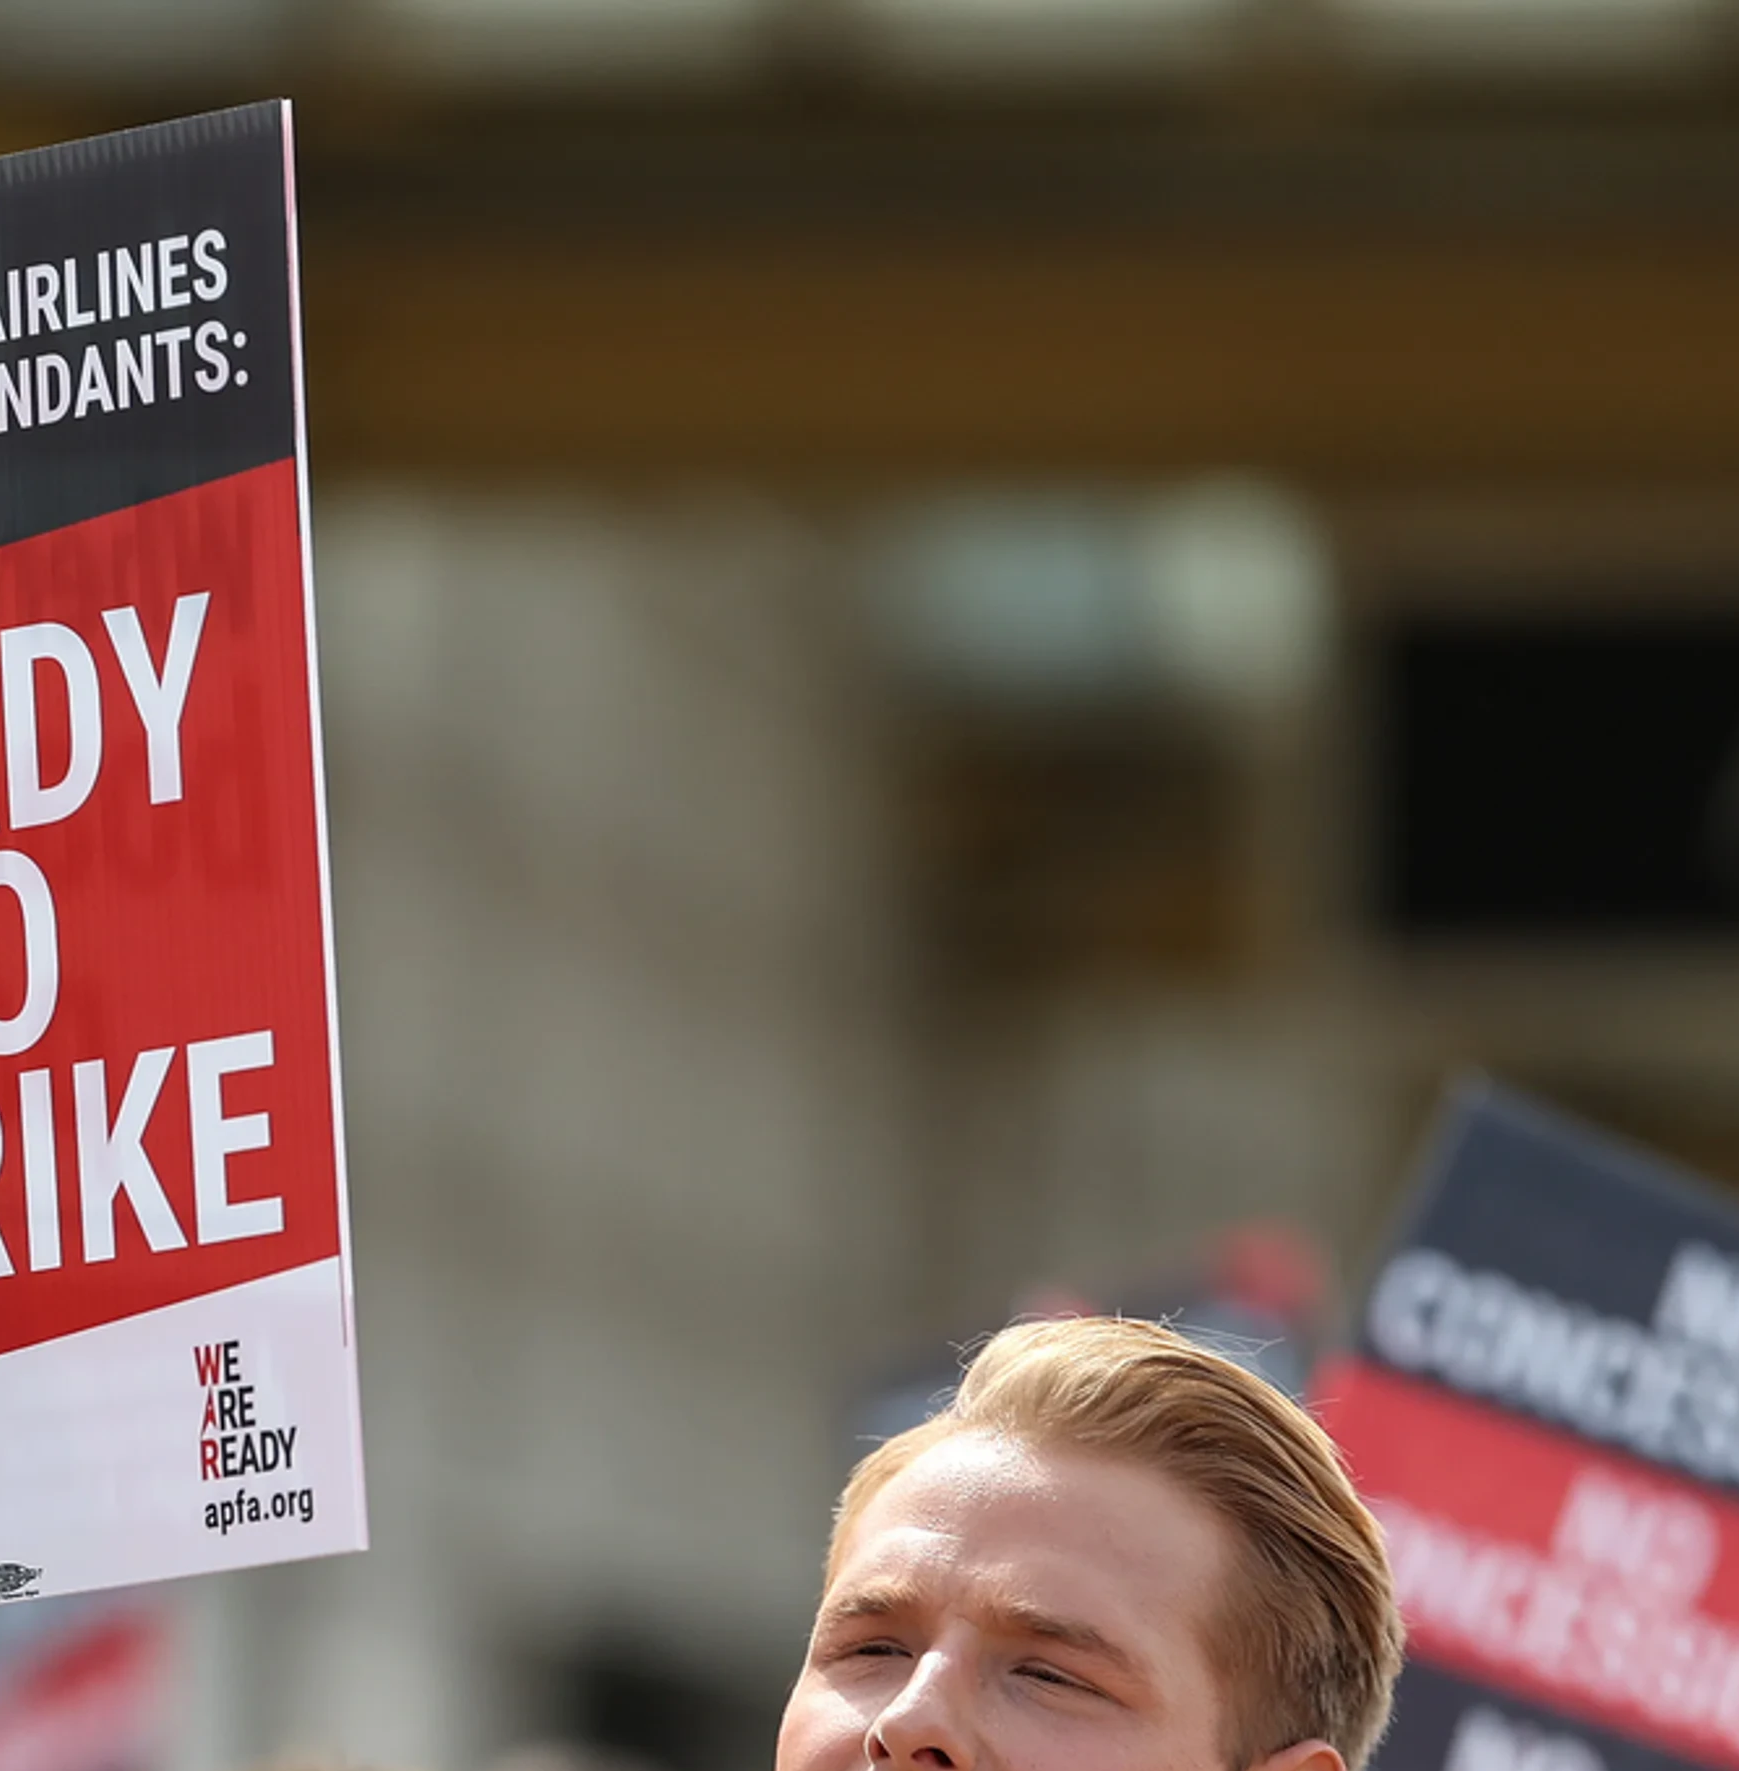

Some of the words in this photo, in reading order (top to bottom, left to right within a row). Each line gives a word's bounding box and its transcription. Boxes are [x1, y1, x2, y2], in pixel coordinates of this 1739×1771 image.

[193, 1340, 241, 1387] WE
[200, 1385, 256, 1438] ARE
[200, 1426, 297, 1481] READY
[204, 1488, 314, 1536] apfa.org
